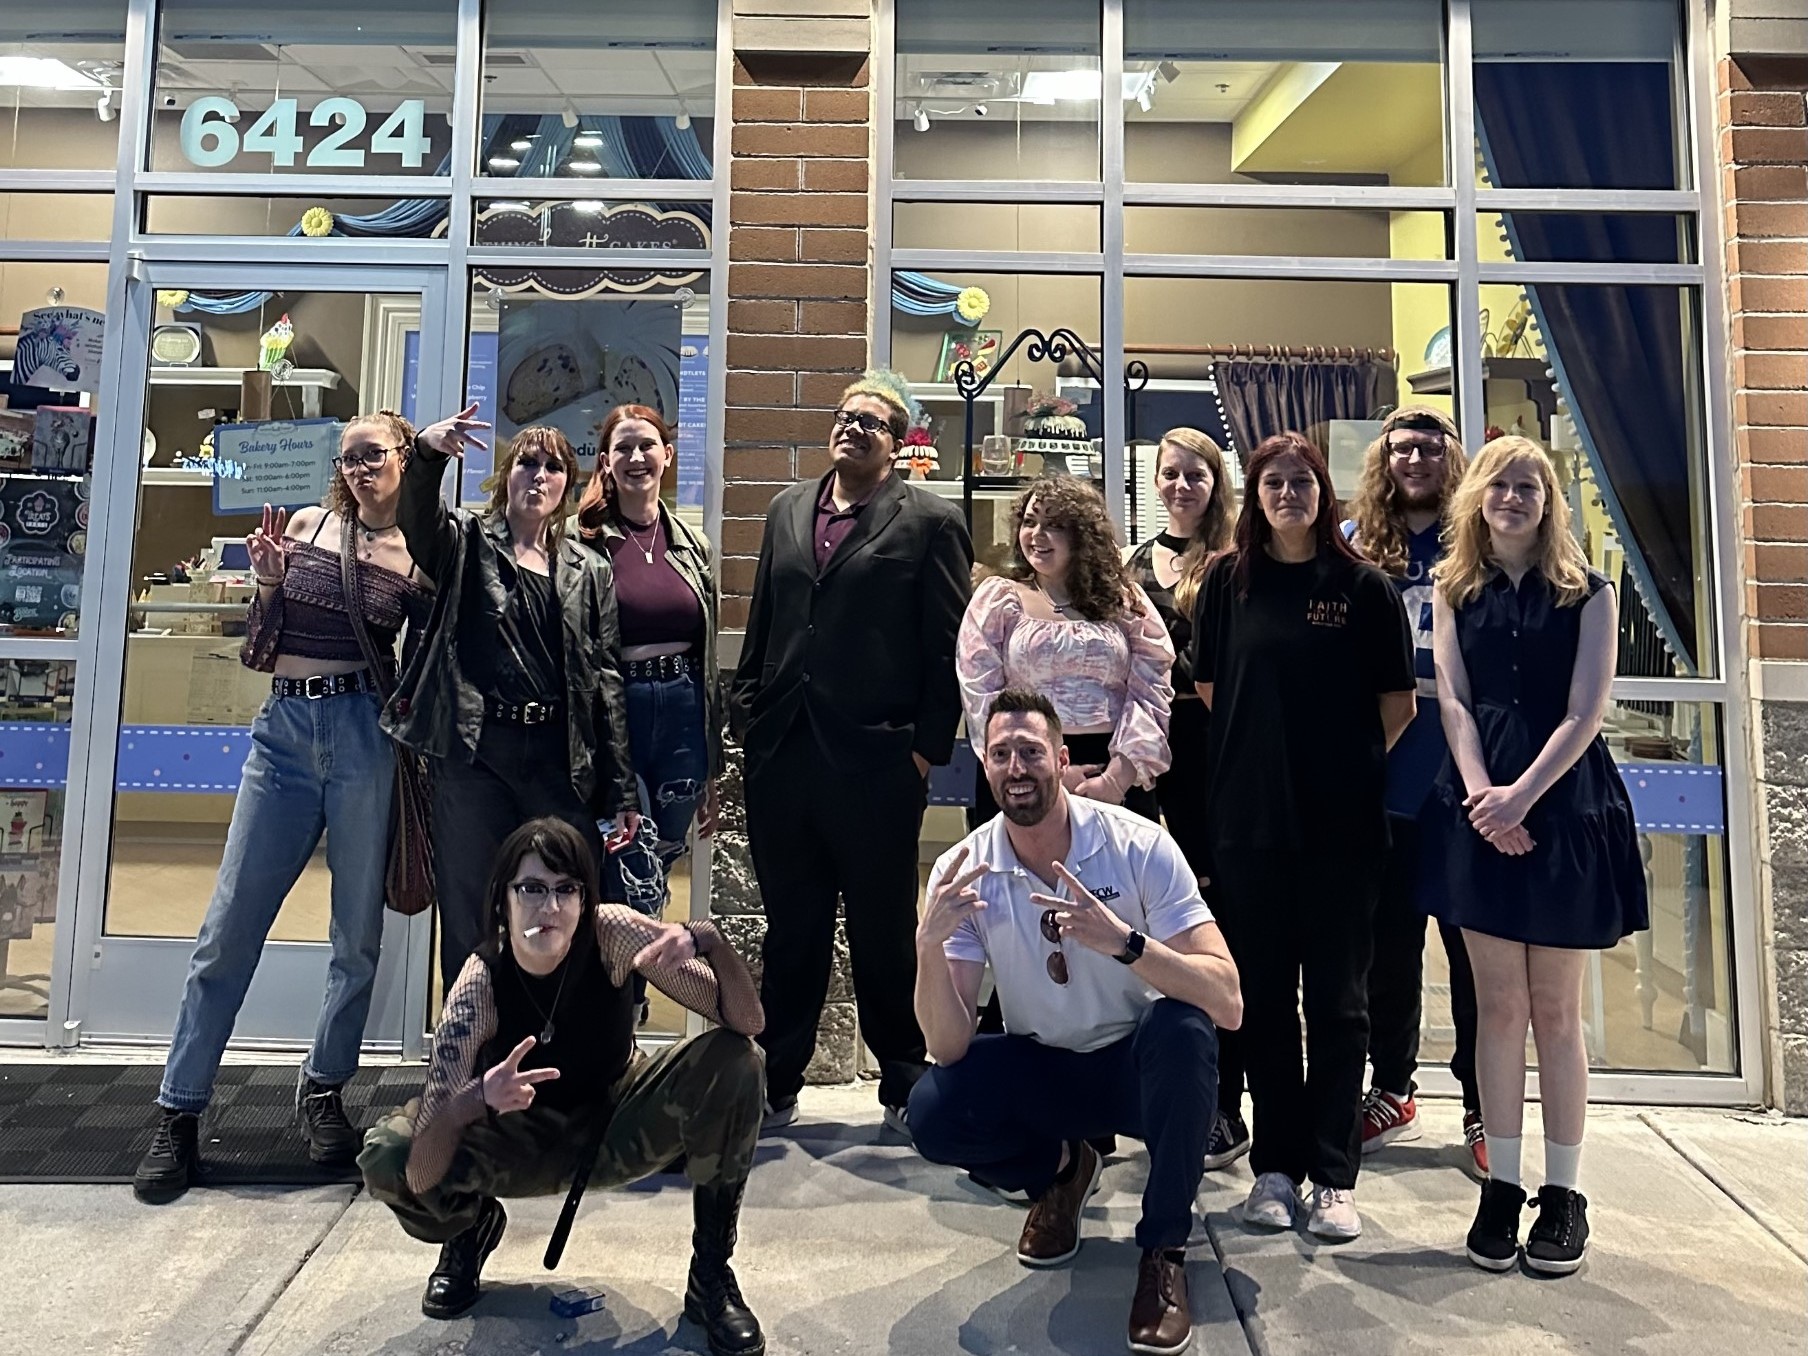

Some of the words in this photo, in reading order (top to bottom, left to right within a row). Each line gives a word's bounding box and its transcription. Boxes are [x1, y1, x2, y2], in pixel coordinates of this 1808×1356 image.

[180, 96, 430, 168] 6424
[92, 317, 105, 326] ne
[238, 440, 277, 454] Bakery
[280, 438, 314, 451] Hours
